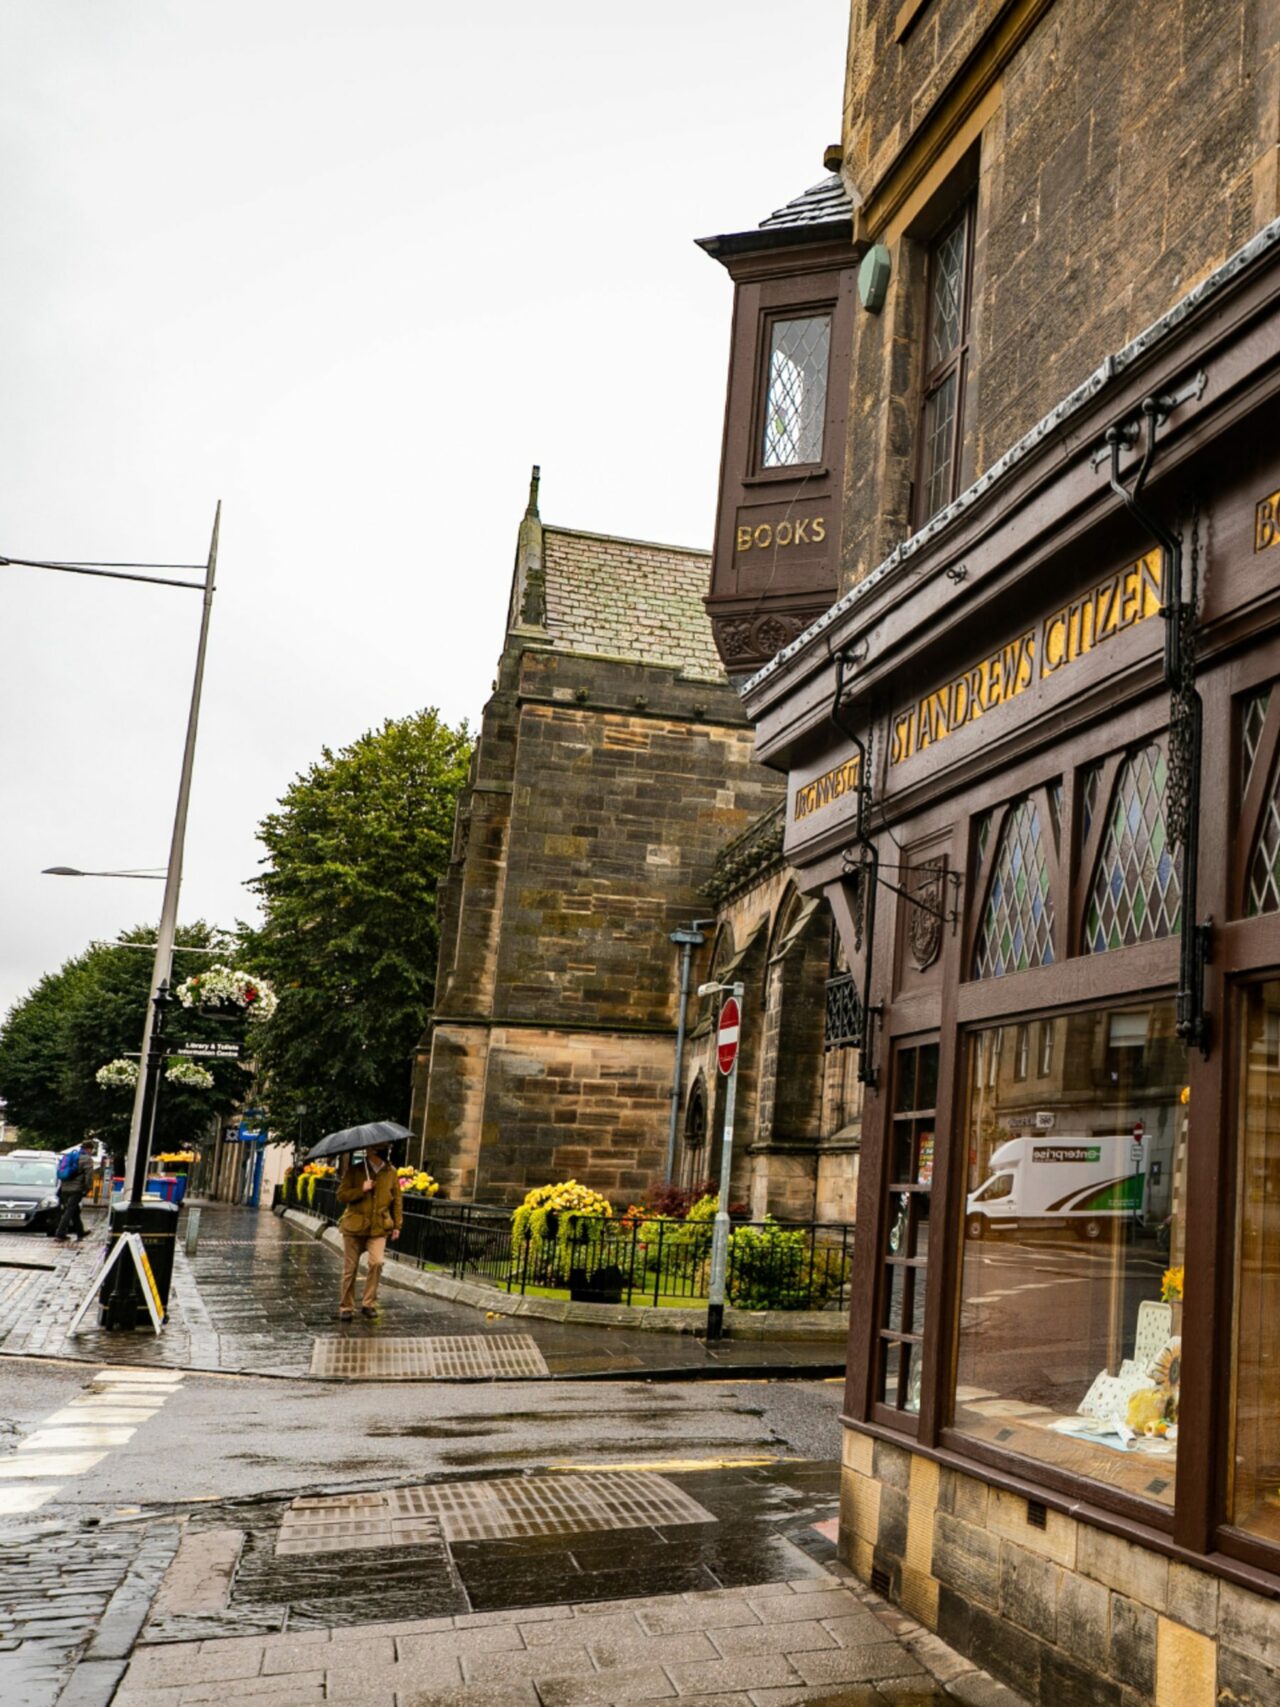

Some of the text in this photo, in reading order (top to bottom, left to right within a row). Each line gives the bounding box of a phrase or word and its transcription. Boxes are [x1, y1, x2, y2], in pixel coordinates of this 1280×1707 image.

[737, 517, 826, 551] BOOKS
[890, 556, 1163, 768] ST ANDREWS CITIZEN
